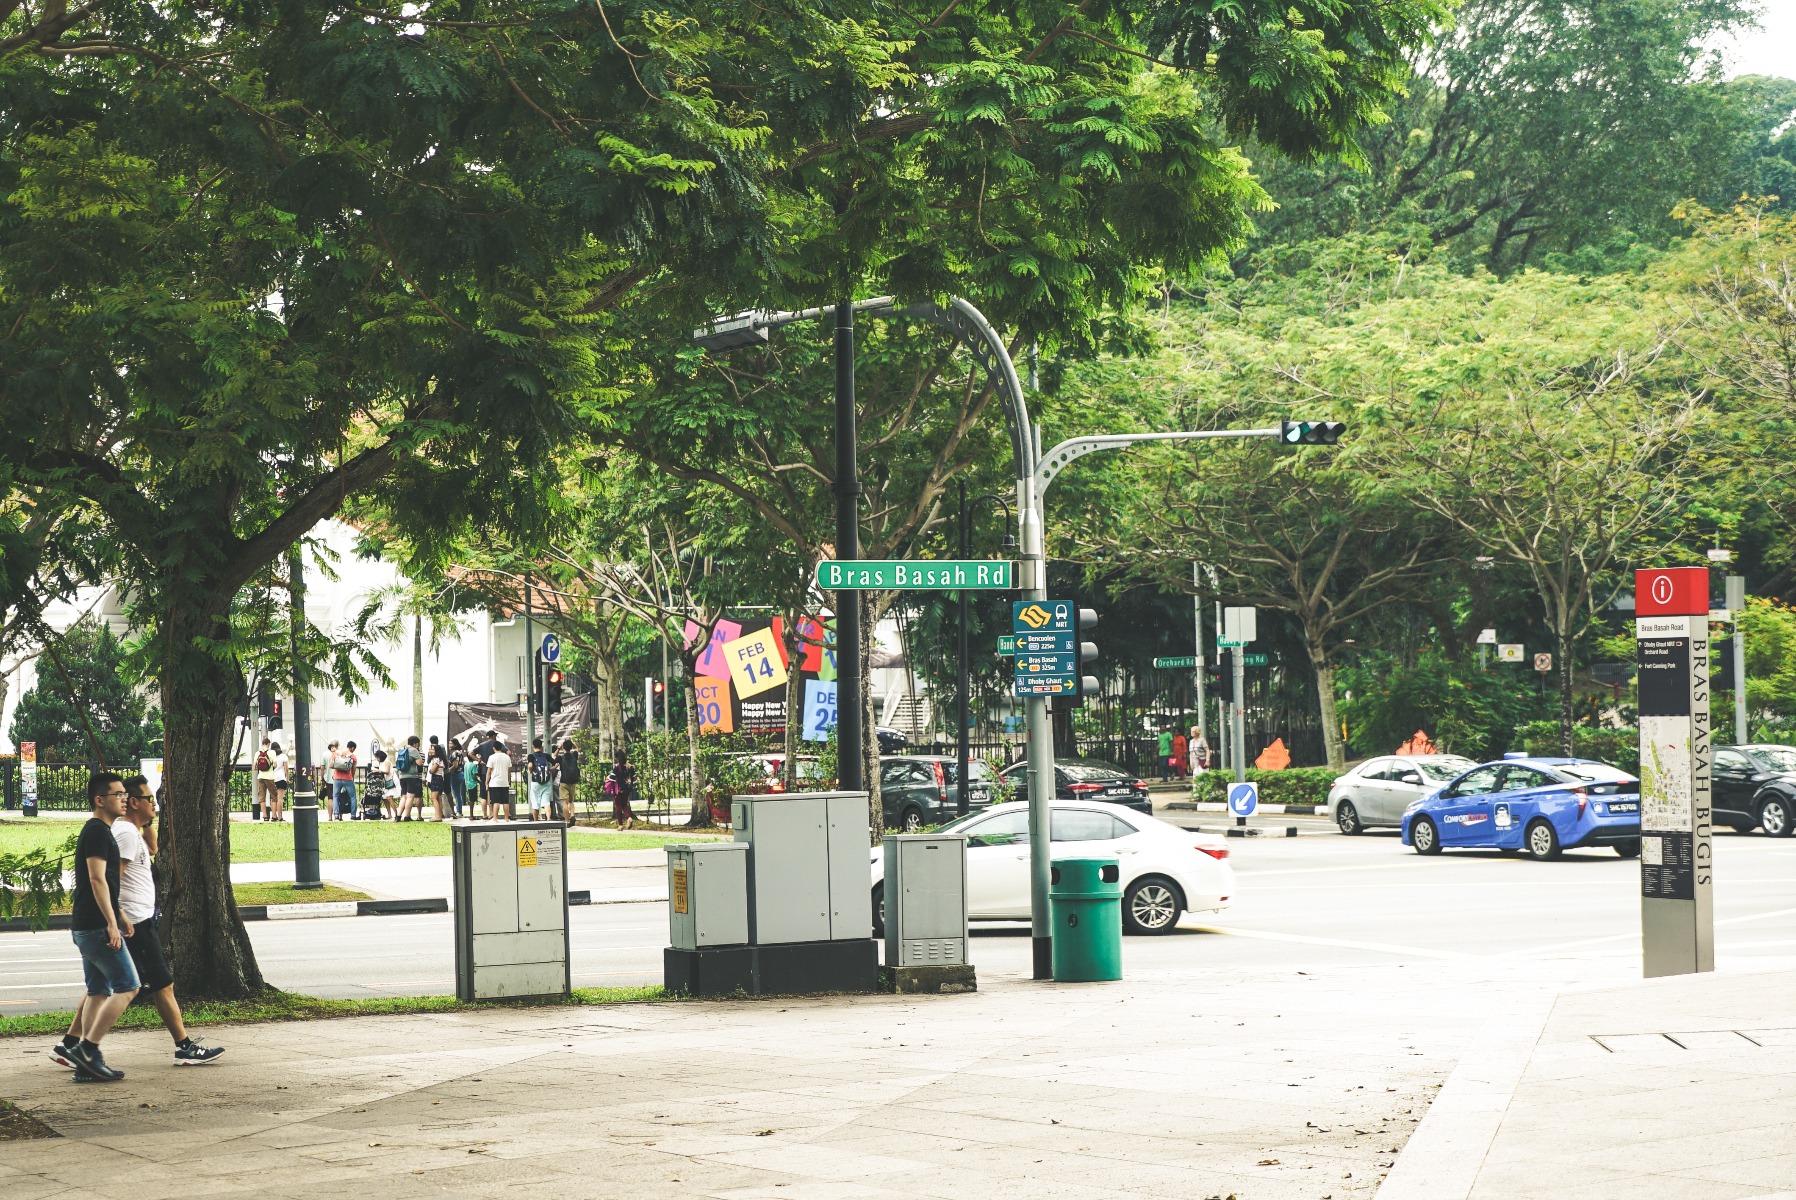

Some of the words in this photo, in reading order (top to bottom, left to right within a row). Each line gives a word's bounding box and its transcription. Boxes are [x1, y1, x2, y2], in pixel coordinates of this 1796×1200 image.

[830, 564, 883, 585] Bras
[895, 564, 966, 585] Basah
[977, 564, 1004, 585] Rd
[1641, 624, 1653, 632] Bras
[1653, 624, 1670, 632] Basah
[1670, 623, 1684, 631] Road
[737, 642, 765, 661] FEB
[1028, 656, 1041, 664] Bras
[1158, 658, 1185, 667] Orchard
[1186, 658, 1194, 666] Rd
[743, 656, 774, 685] 14
[1693, 639, 1708, 702] BRAS
[695, 686, 718, 699] OCT
[816, 691, 837, 705] DE
[741, 702, 764, 711] Happy
[765, 701, 781, 709] New
[741, 709, 764, 718] Happy
[765, 709, 781, 717] New
[301, 767, 307, 776] 2
